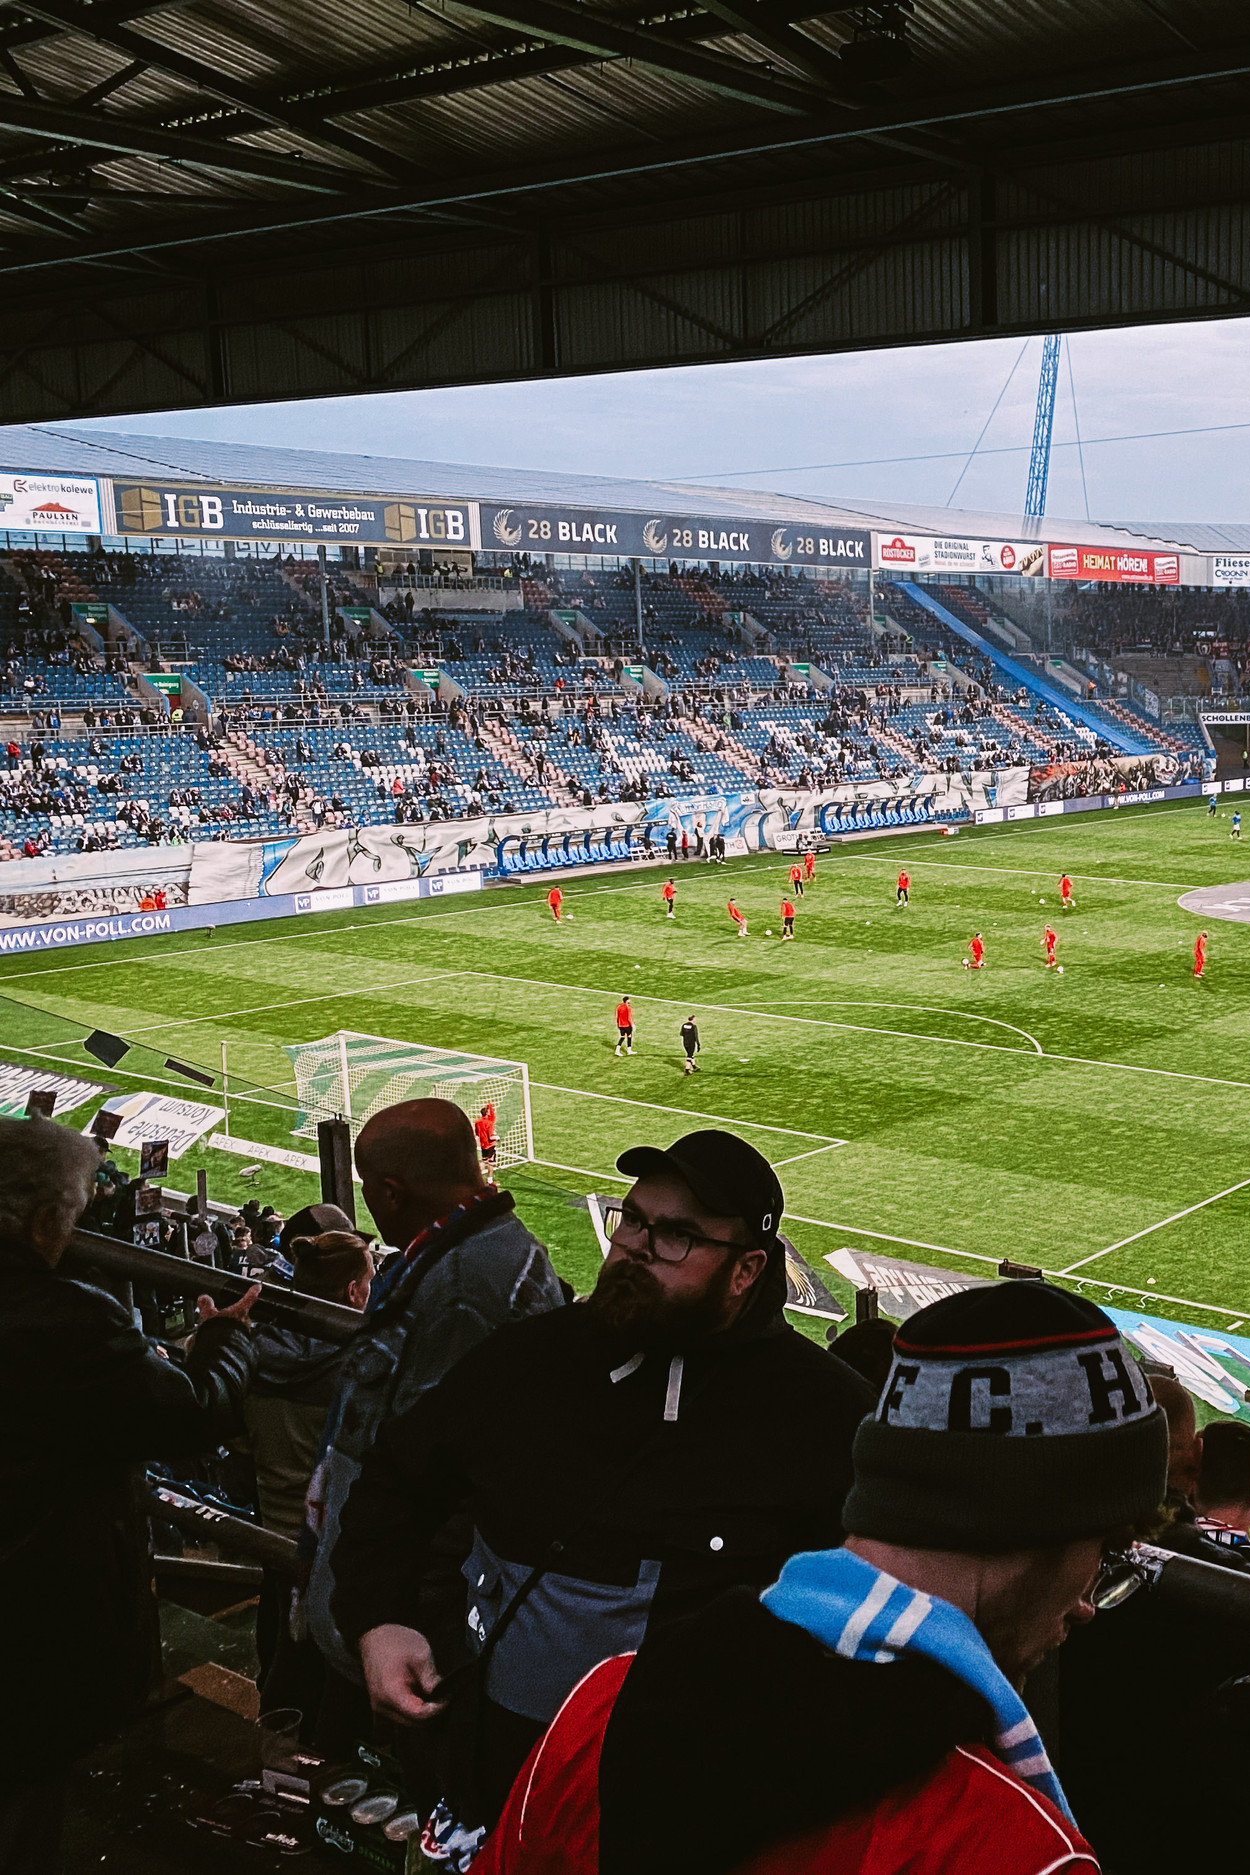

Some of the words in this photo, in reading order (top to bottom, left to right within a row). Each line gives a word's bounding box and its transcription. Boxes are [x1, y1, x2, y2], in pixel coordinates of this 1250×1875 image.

[28, 482, 60, 492] elektro
[60, 484, 94, 494] kolewe
[32, 511, 78, 520] PAULSEN
[164, 493, 224, 530] IGB
[232, 500, 292, 516] Industrie-
[295, 504, 305, 518] &
[308, 504, 375, 521] Gewerbebau
[252, 519, 313, 534] schlüsselfertig
[338, 523, 360, 534] 2007
[418, 508, 464, 540] IGB
[527, 518, 552, 540] 28
[558, 520, 618, 544] BLACK
[672, 528, 693, 548] 28
[698, 530, 750, 552] BLACK
[796, 536, 814, 554] 28
[818, 538, 864, 558] BLACK
[934, 541, 943, 549] DIE
[944, 542, 969, 550] ORIGINAL
[882, 548, 915, 560] ROSTOCKER
[934, 550, 976, 560] STADIONWURST
[1082, 554, 1115, 570] HEIMAT
[1116, 554, 1148, 572] HÖREN!
[158, 1101, 215, 1126] Konsum
[128, 1120, 198, 1152] Deutsche
[213, 1135, 235, 1149] APEX
[248, 1144, 271, 1158] APEX
[284, 1152, 307, 1167] APEX
